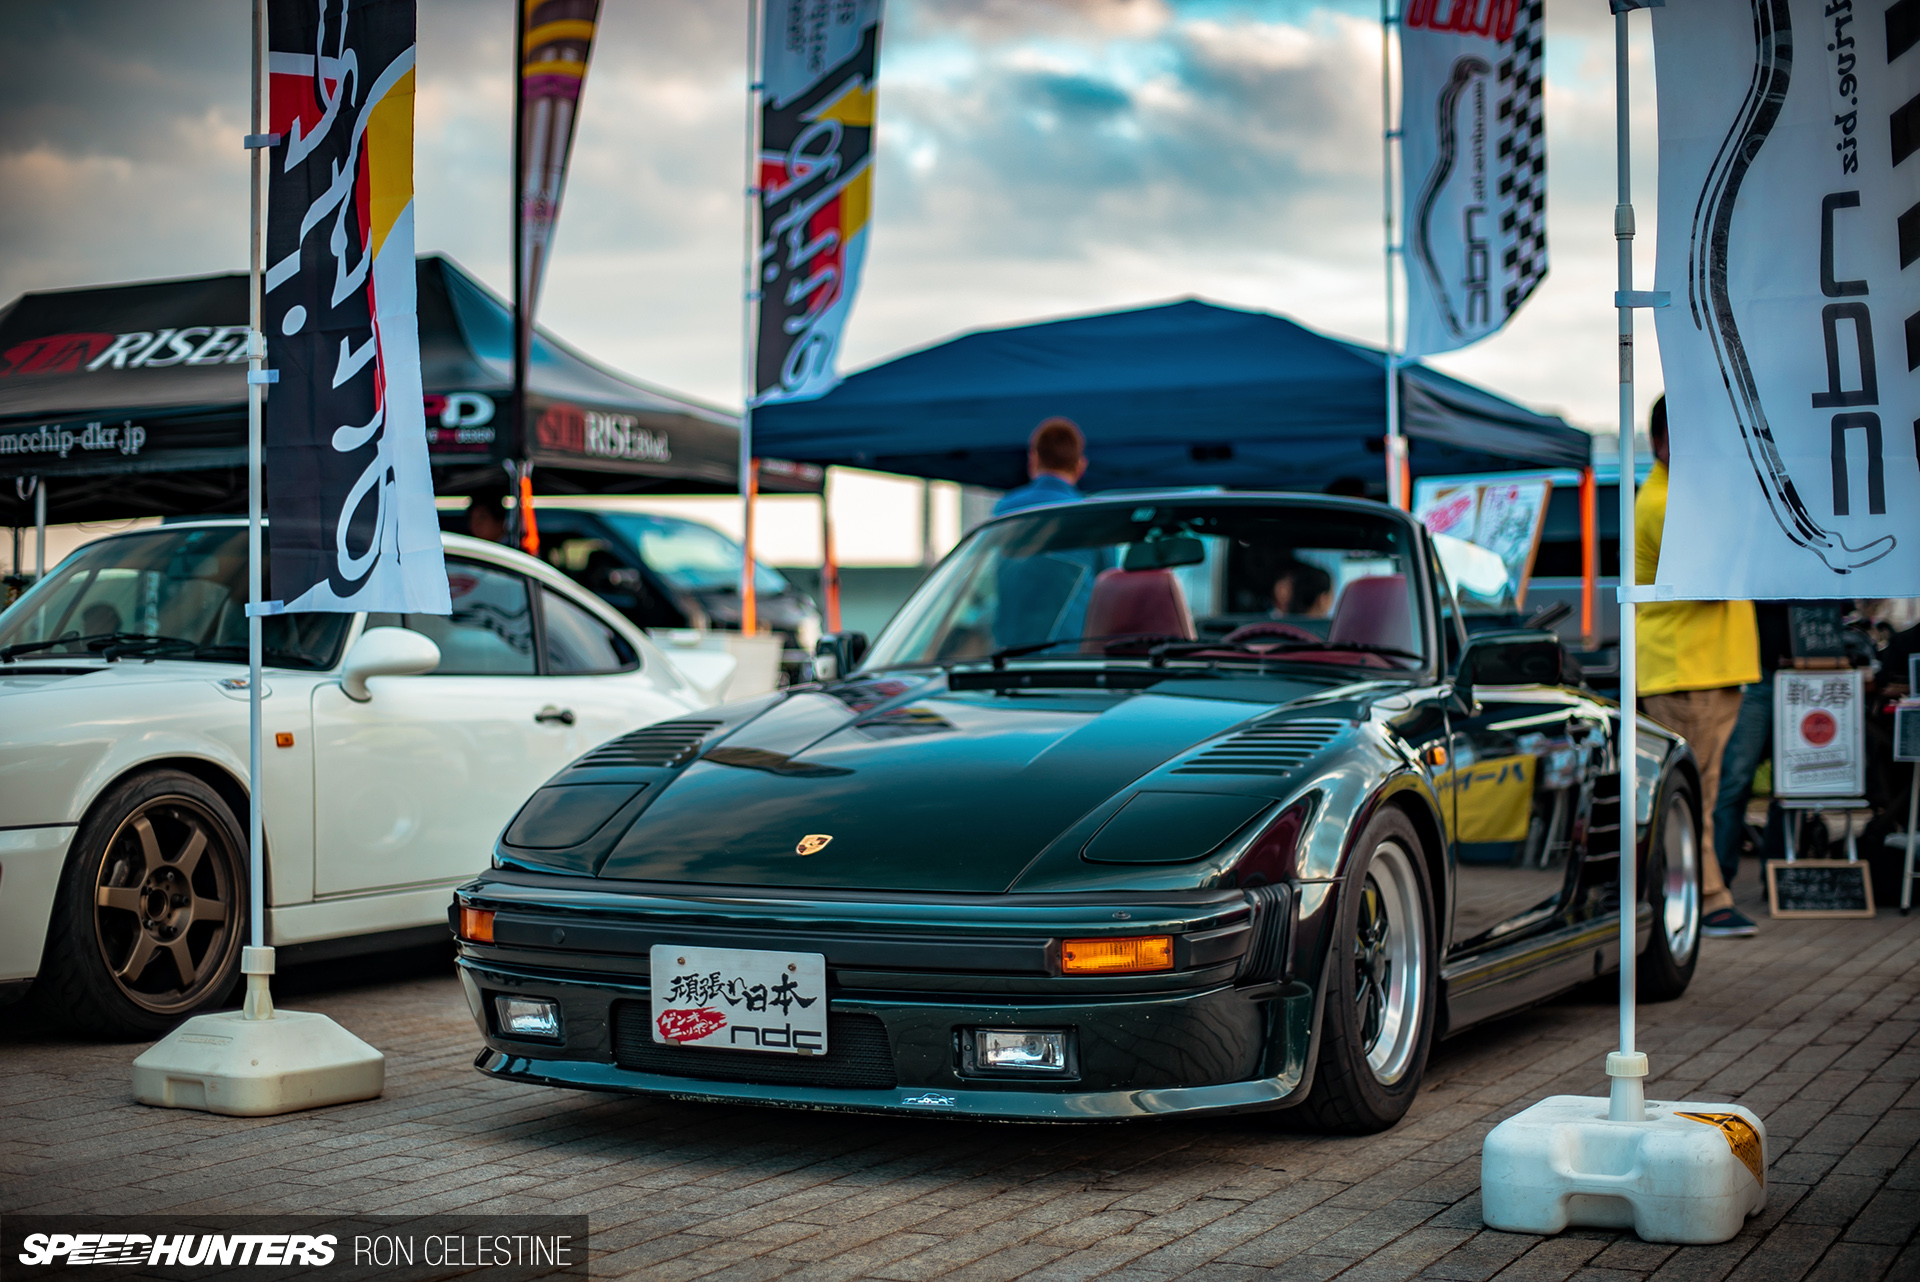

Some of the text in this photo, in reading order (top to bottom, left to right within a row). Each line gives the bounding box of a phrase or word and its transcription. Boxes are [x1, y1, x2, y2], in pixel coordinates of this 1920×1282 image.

[663, 971, 818, 1017] 頑張れ日本
[731, 1022, 823, 1050] ndc
